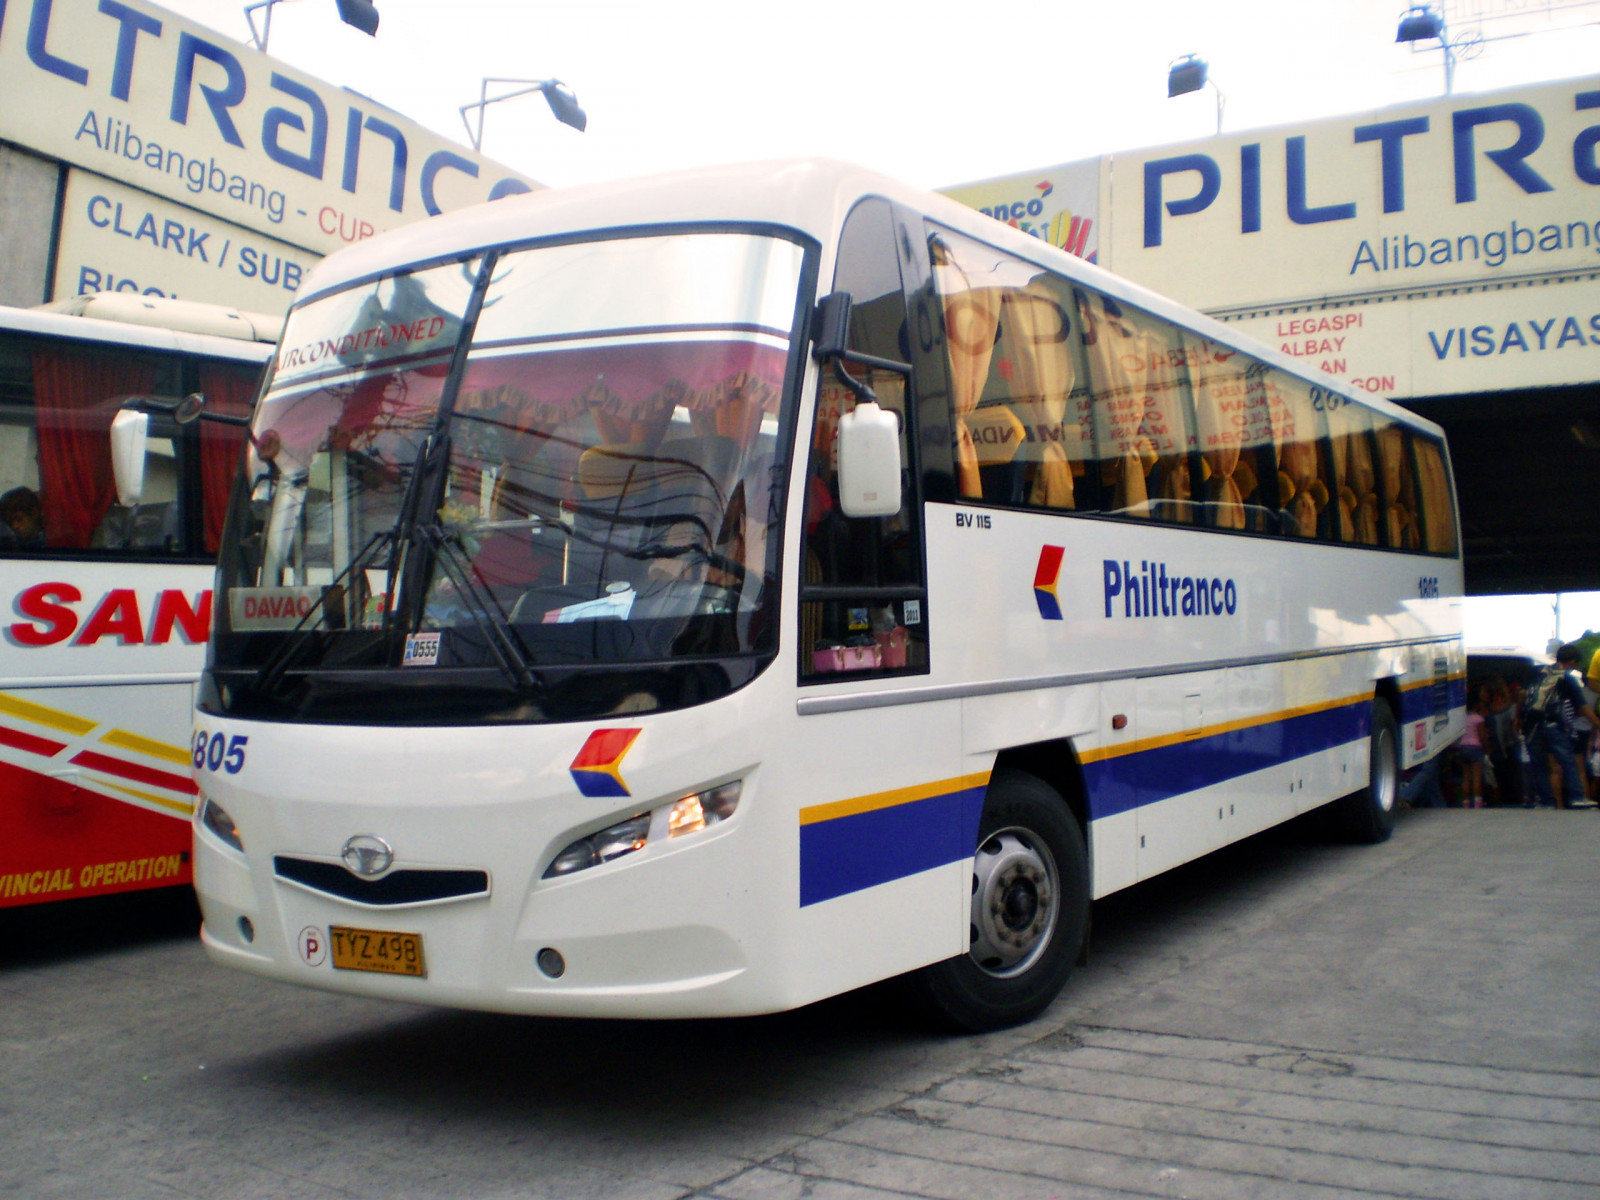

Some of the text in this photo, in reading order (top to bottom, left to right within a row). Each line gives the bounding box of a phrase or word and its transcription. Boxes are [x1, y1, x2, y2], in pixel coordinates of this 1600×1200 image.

[75, 110, 286, 224] Alibangbang
[87, 195, 306, 291] CLARK / SUB
[1278, 313, 1363, 337] LEGASPI
[1281, 336, 1346, 356] ALBAY
[1320, 359, 1347, 375] AN
[956, 513, 992, 529] BV 115
[1103, 559, 1237, 618] Philtranco
[10, 582, 212, 645] SAN
[244, 596, 310, 618] DAVAO
[412, 640, 438, 658] 0555
[191, 730, 249, 775] 805
[79, 853, 181, 888] OPERATION
[306, 938, 318, 959] P
